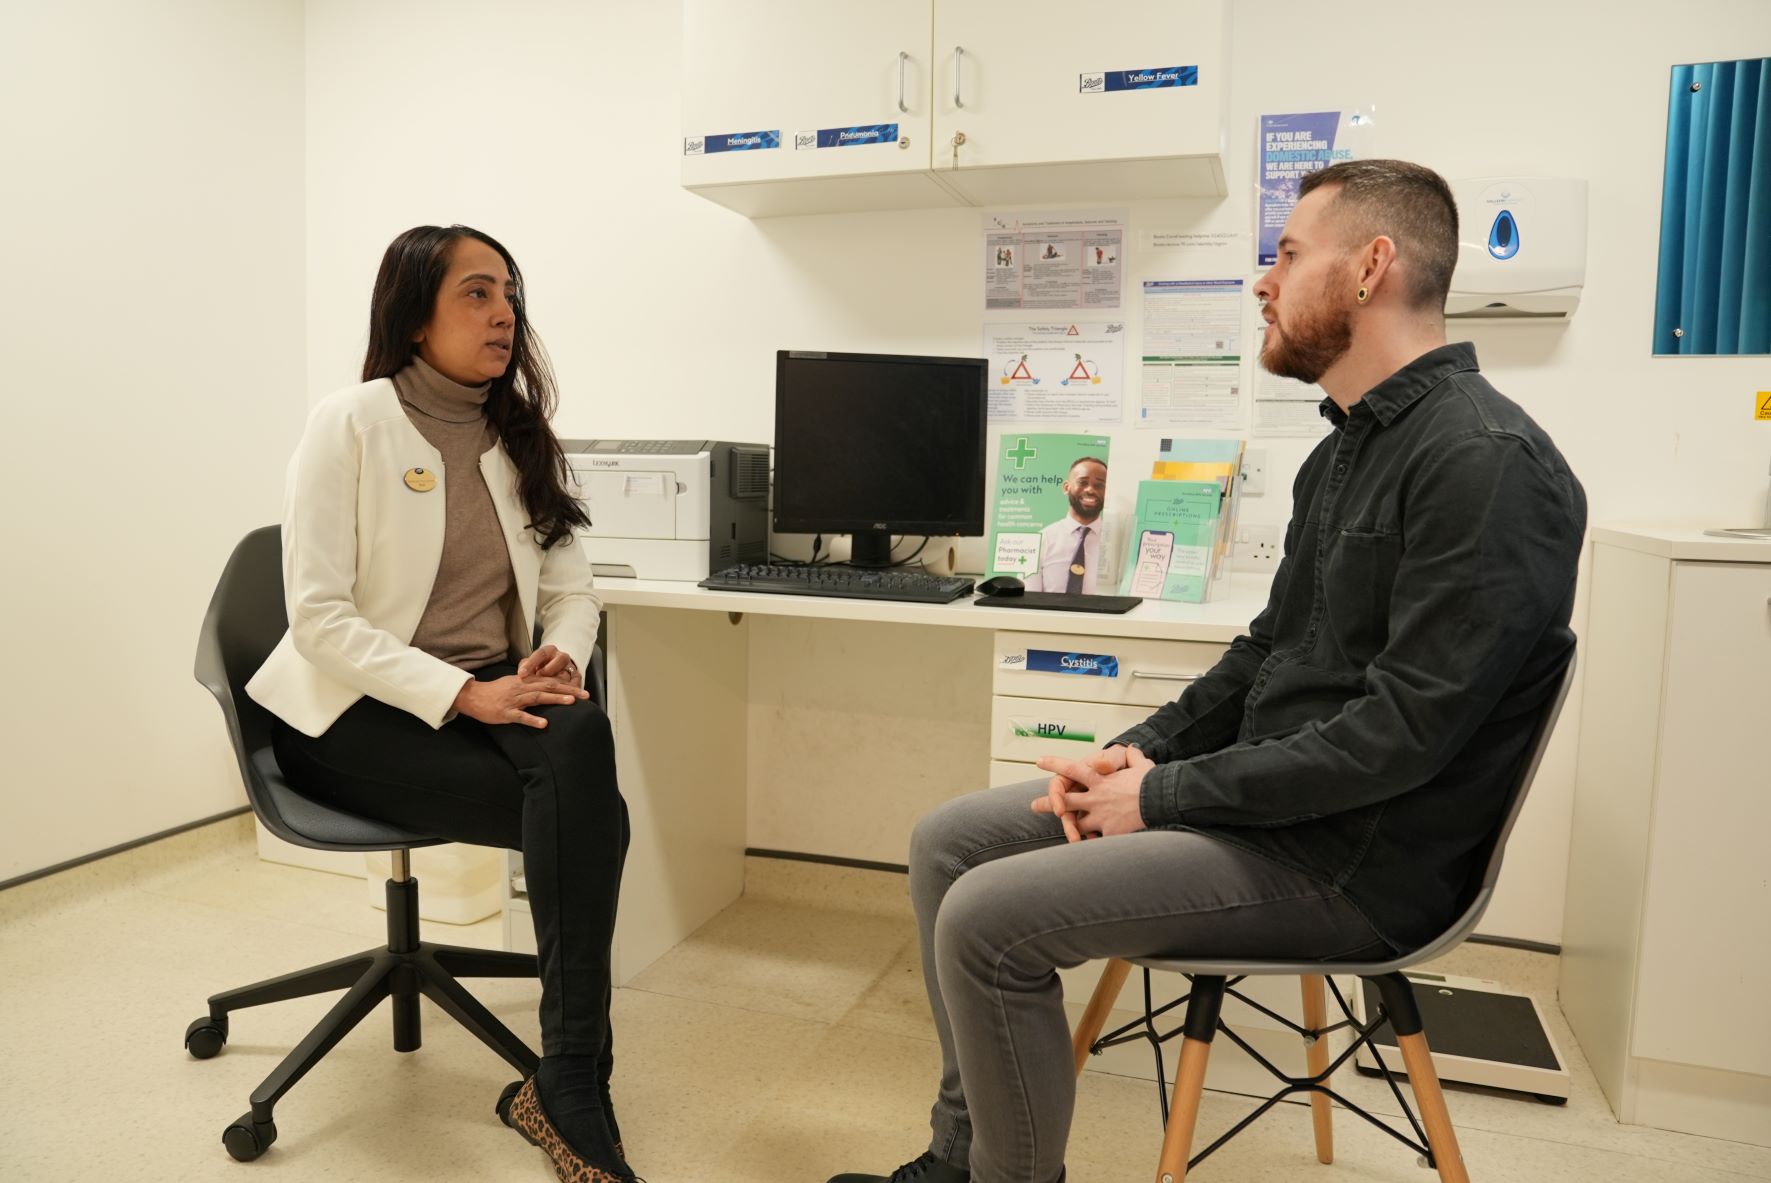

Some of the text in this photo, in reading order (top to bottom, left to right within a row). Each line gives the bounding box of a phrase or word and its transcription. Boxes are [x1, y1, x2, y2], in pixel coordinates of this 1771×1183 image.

[1128, 71, 1179, 82] Yellow Fever
[727, 136, 761, 146] Meningitis
[1266, 131, 1312, 142] IF YOU ARE
[1266, 140, 1328, 152] EXPERIENCING
[1266, 150, 1317, 162] DOMESTIC
[1266, 161, 1325, 171] WE ARE HERE TO
[1266, 170, 1300, 180] SUPPORT
[1003, 474, 1063, 487] We can help
[1002, 485, 1042, 497] you with
[997, 555, 1016, 563] today
[1060, 655, 1098, 669] Cystitis
[1038, 722, 1066, 736] HPV
